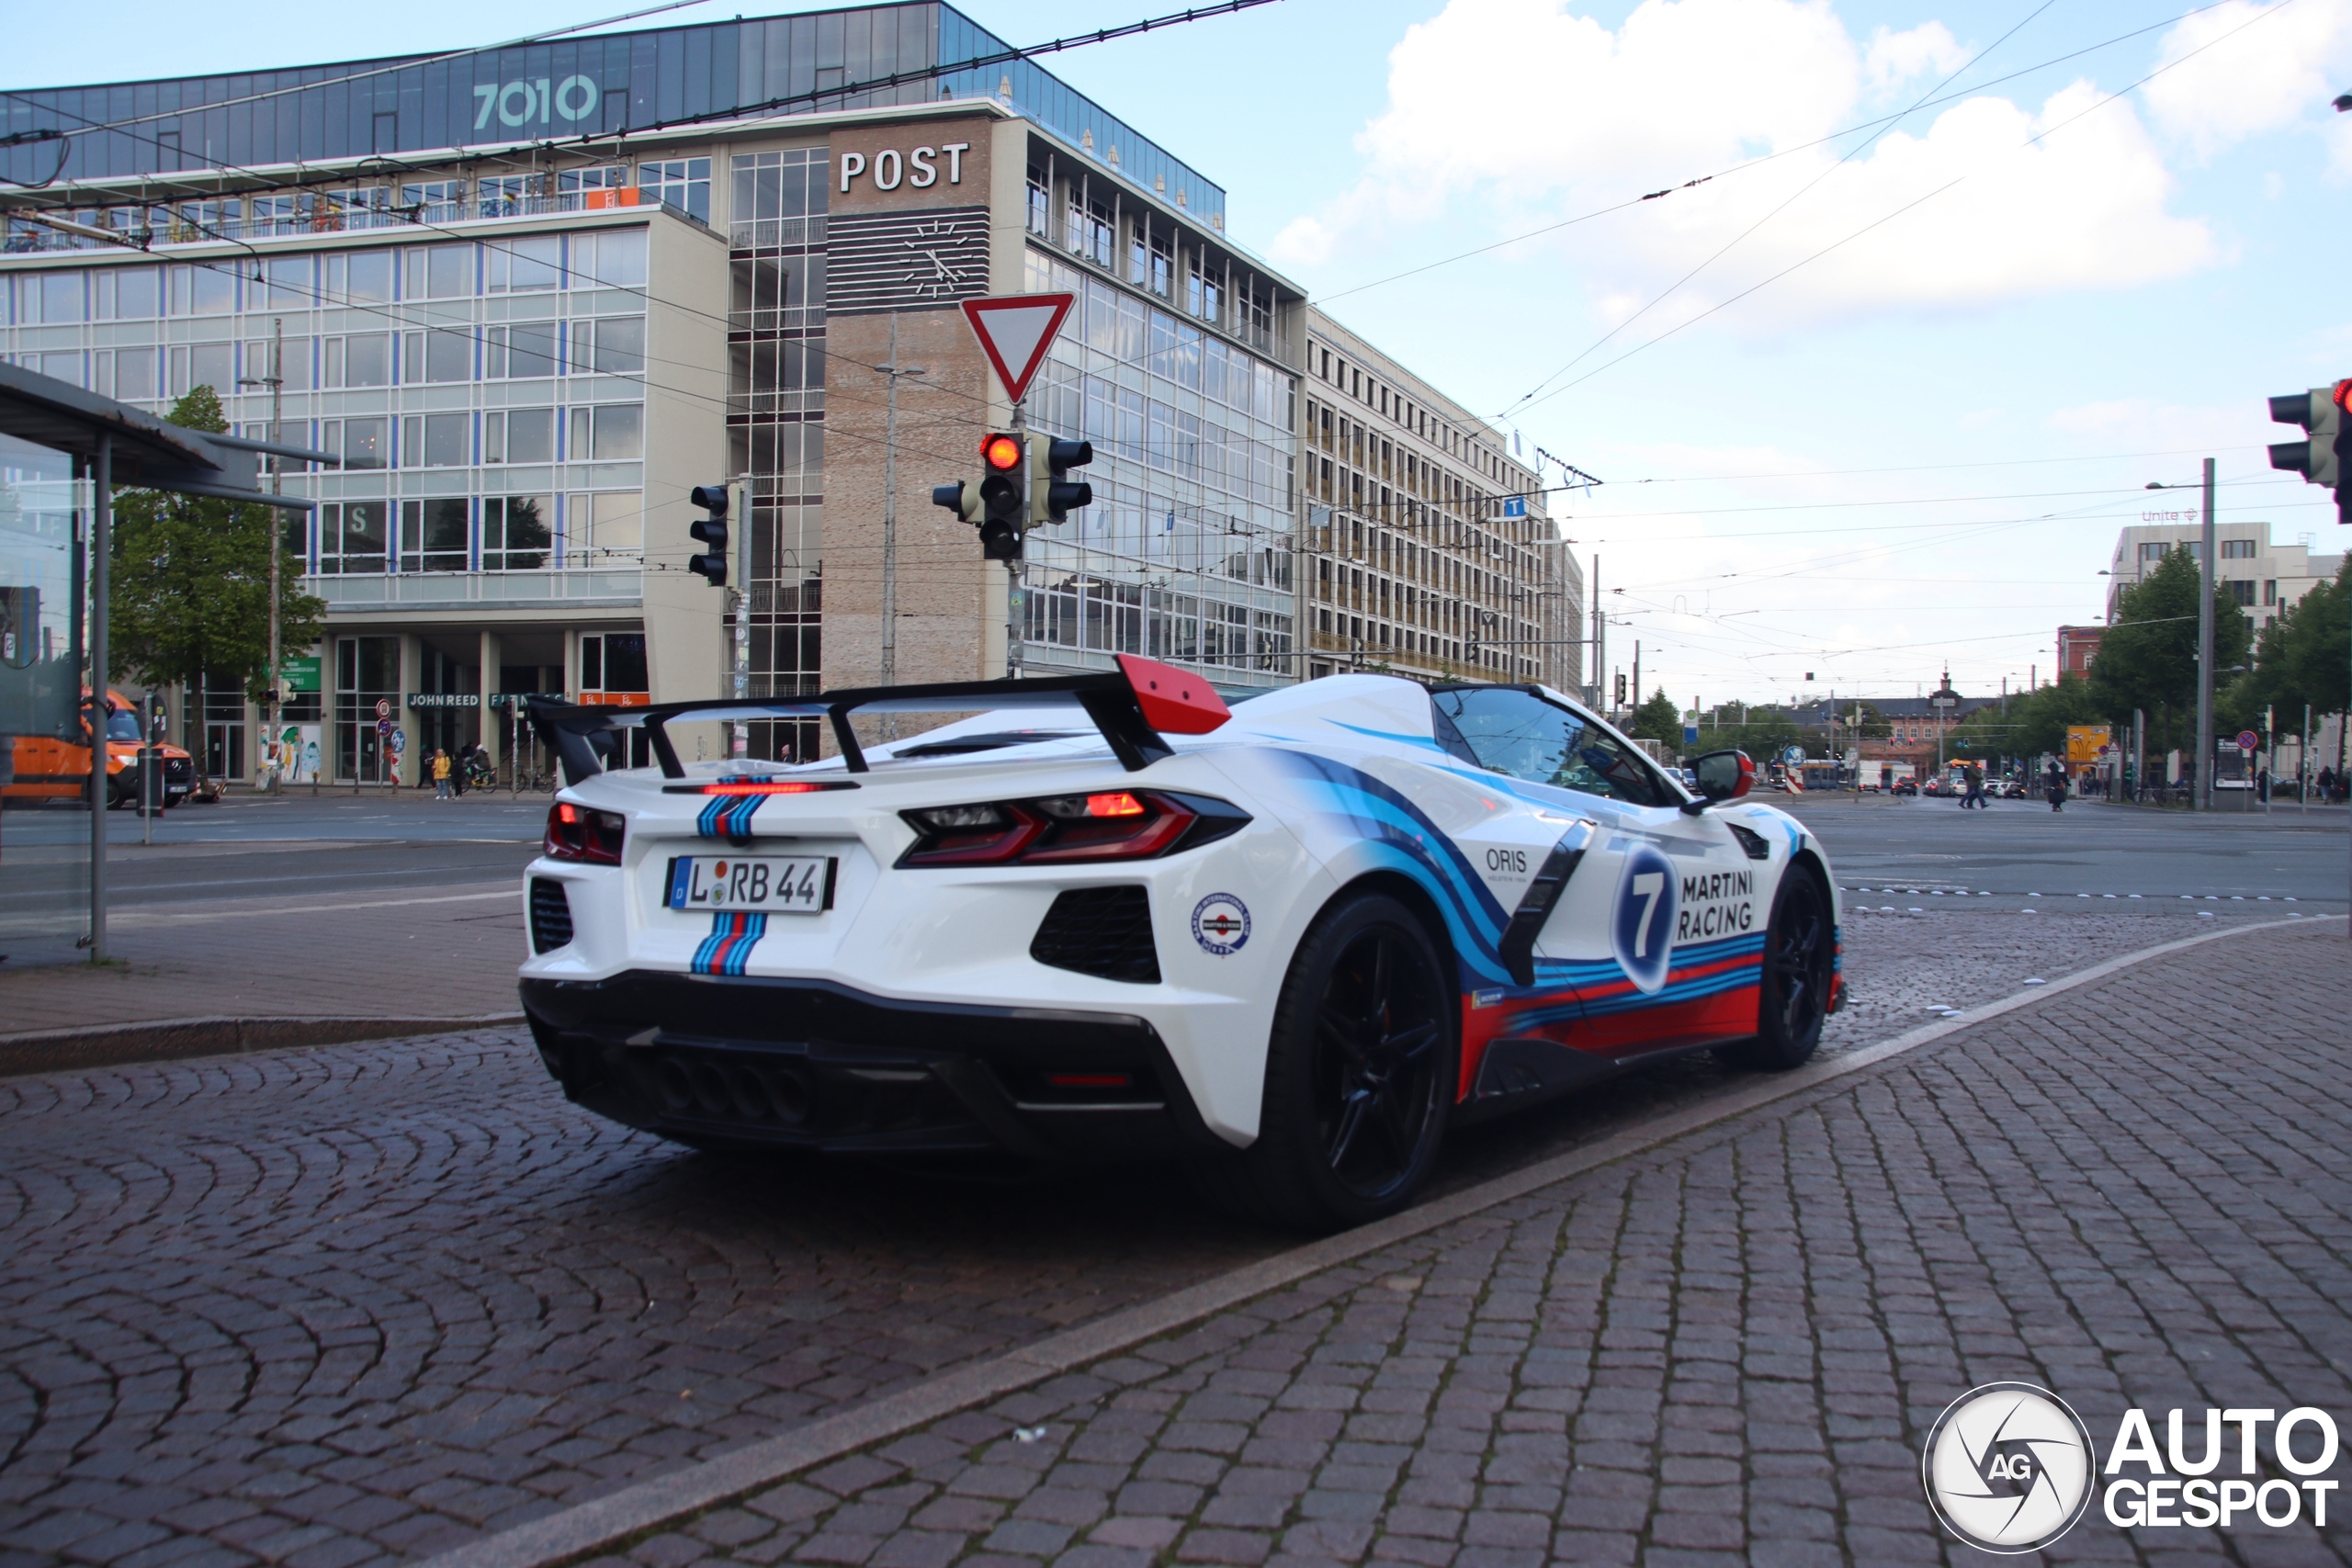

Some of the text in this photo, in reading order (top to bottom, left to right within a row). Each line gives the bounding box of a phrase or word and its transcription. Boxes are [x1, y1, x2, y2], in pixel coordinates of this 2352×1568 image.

[473, 74, 597, 130] 7010
[841, 143, 970, 192] POST
[1509, 500, 1521, 514] T
[2143, 510, 2178, 521] Unite
[410, 694, 479, 705] JOHN REED
[1487, 848, 1527, 873] ORIS
[675, 887, 684, 900] D
[691, 863, 817, 905] L RB 44
[1682, 870, 1753, 903] MARTINI
[1633, 872, 1665, 958] 7
[1678, 901, 1752, 941] RACING
